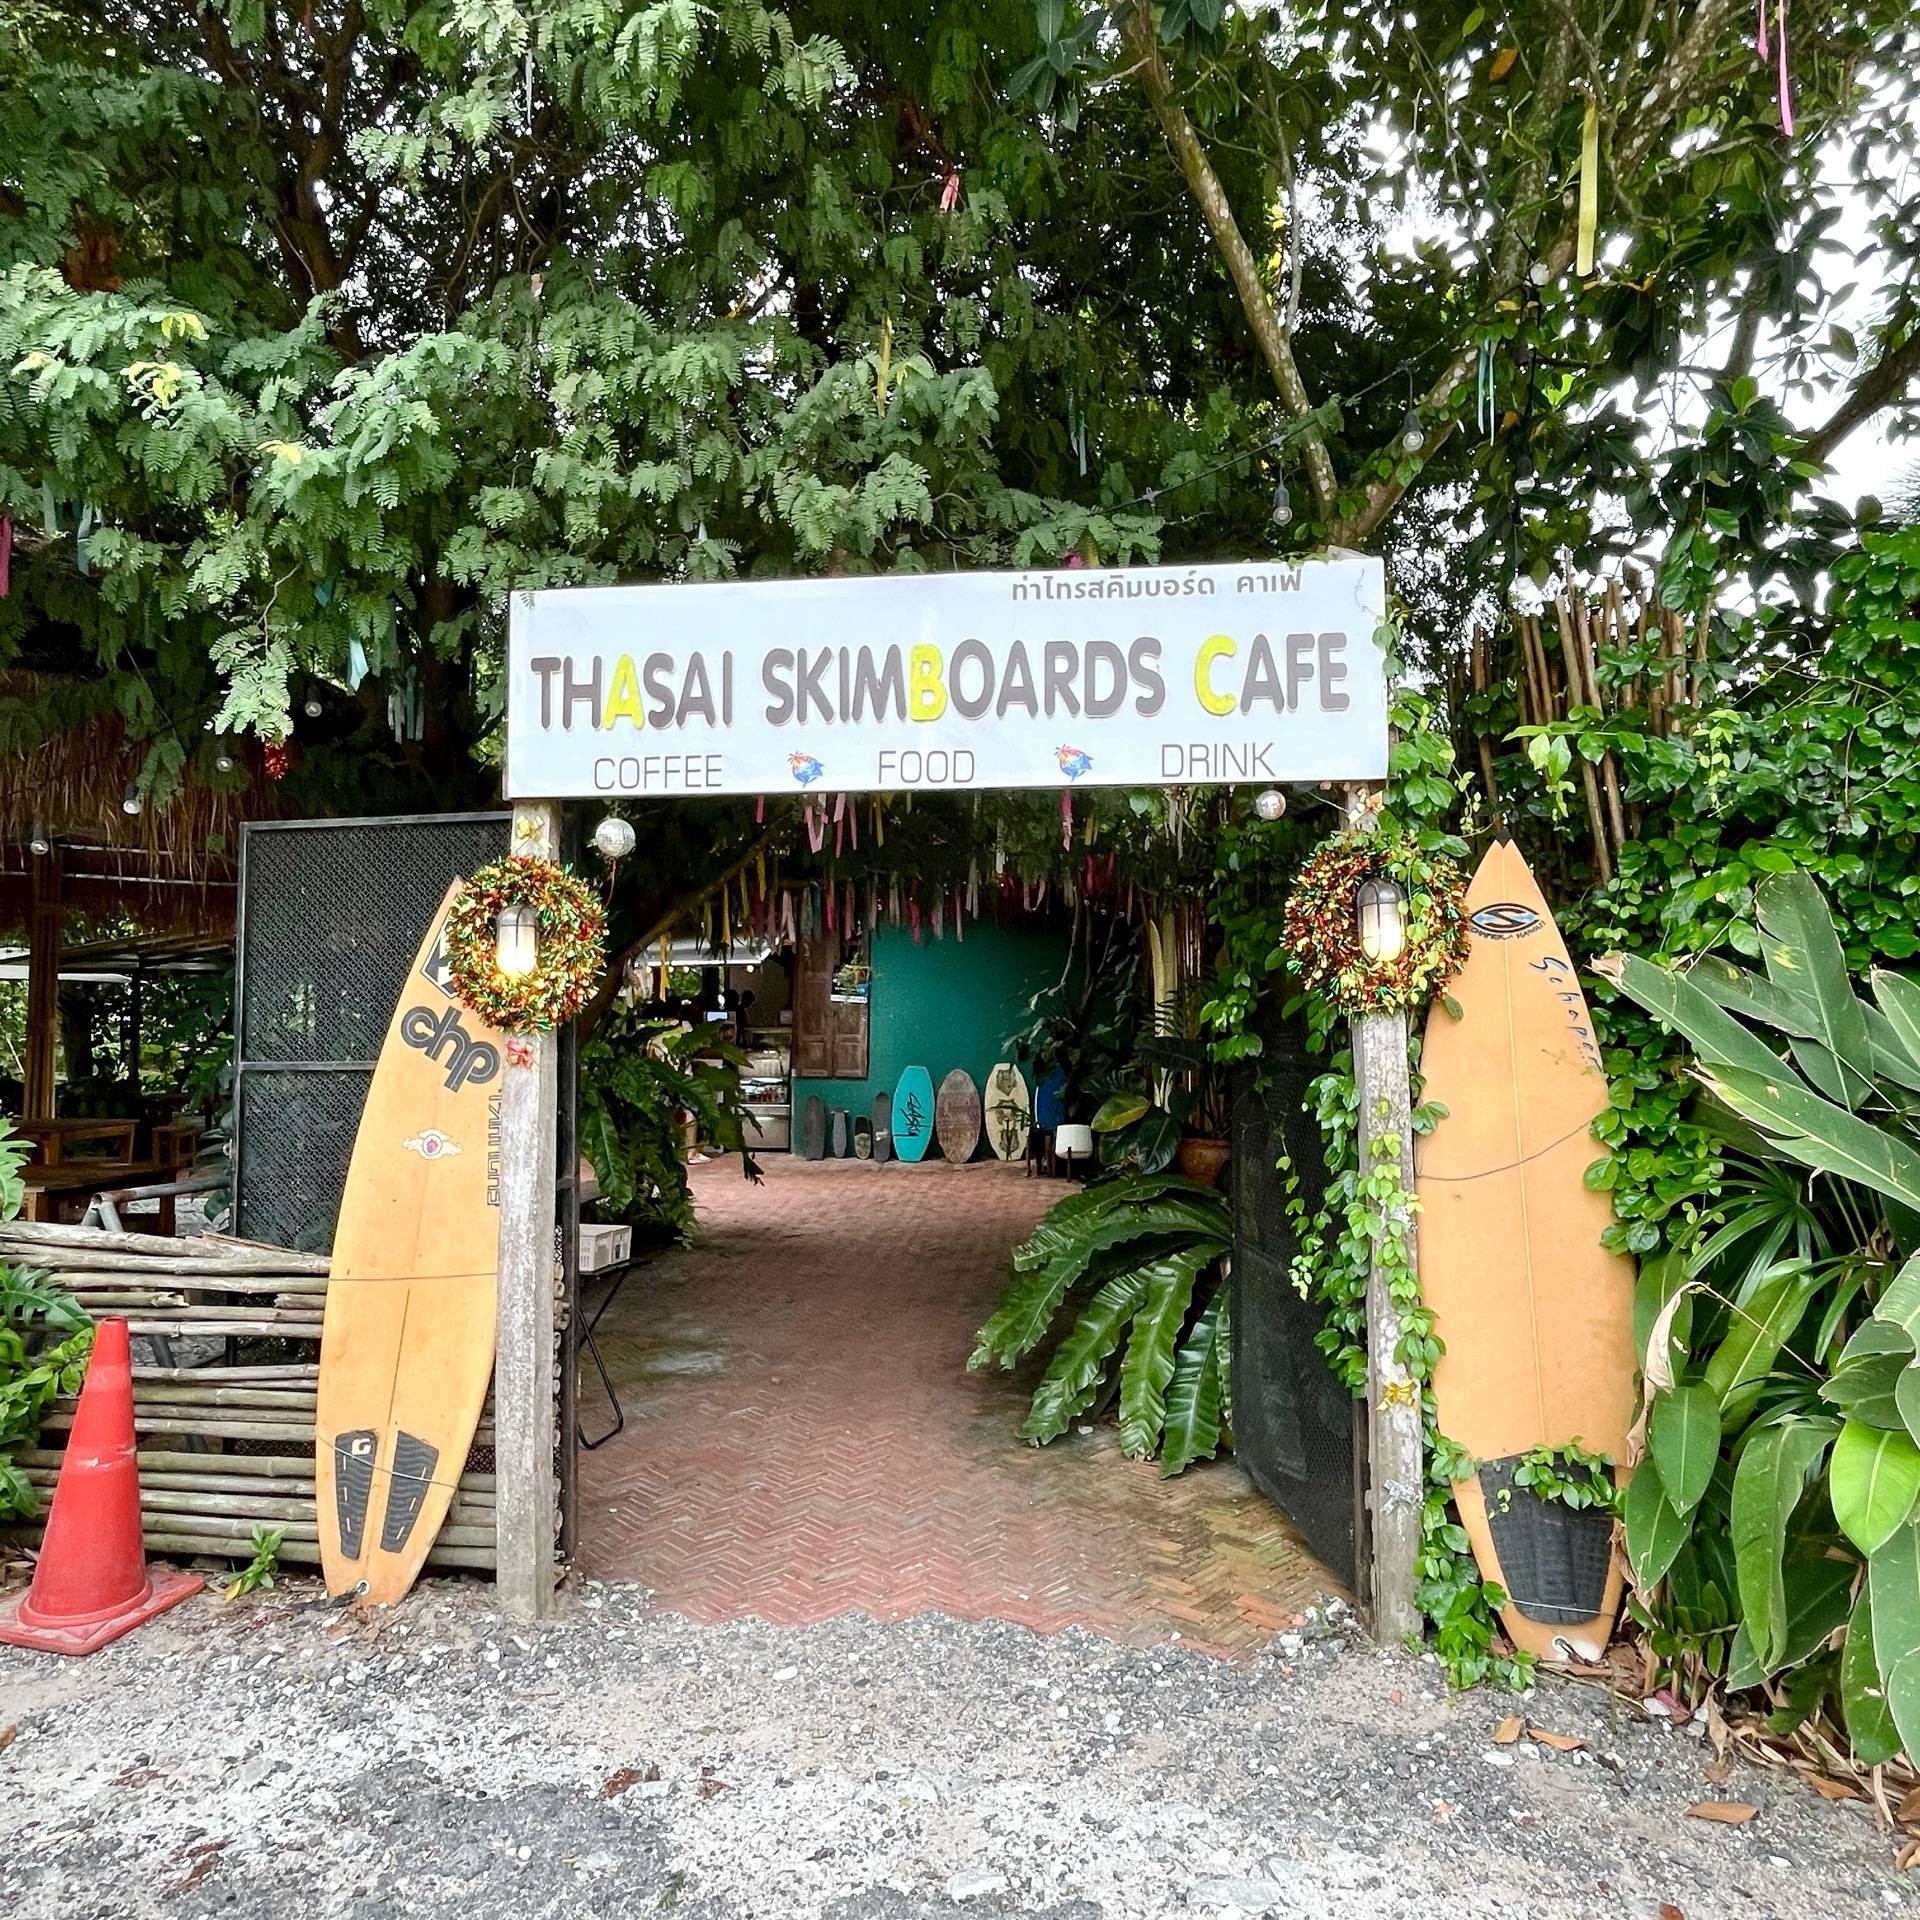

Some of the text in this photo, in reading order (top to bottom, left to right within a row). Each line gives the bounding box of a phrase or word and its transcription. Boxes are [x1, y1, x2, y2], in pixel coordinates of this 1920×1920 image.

[531, 632, 1350, 730] THASAI SKIMBOARDS CAFE
[594, 742, 1276, 790] COFFEE FOOD DRINK
